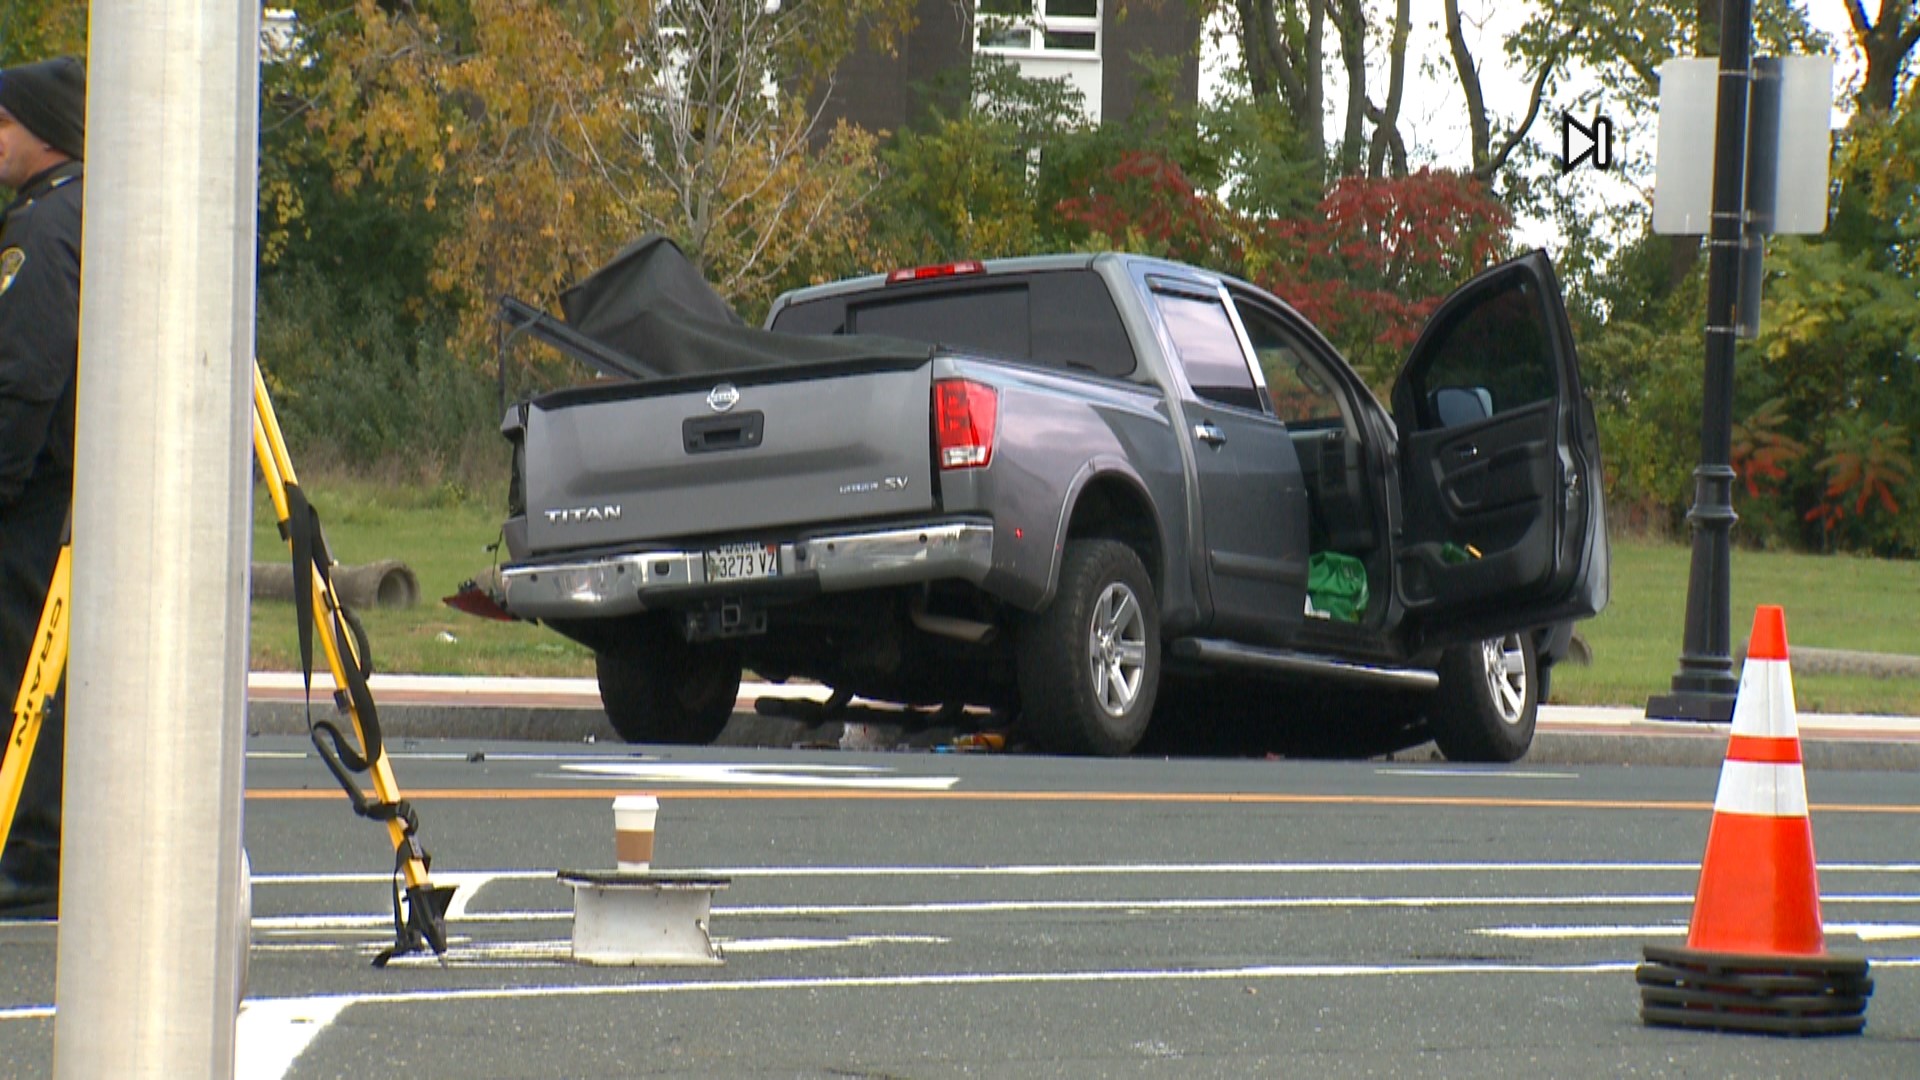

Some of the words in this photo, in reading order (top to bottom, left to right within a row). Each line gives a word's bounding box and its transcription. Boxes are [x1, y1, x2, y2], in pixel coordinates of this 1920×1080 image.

[884, 476, 908, 491] SV
[543, 504, 622, 524] TITAN
[719, 554, 754, 578] 3273
[15, 596, 63, 747] CRAIN
